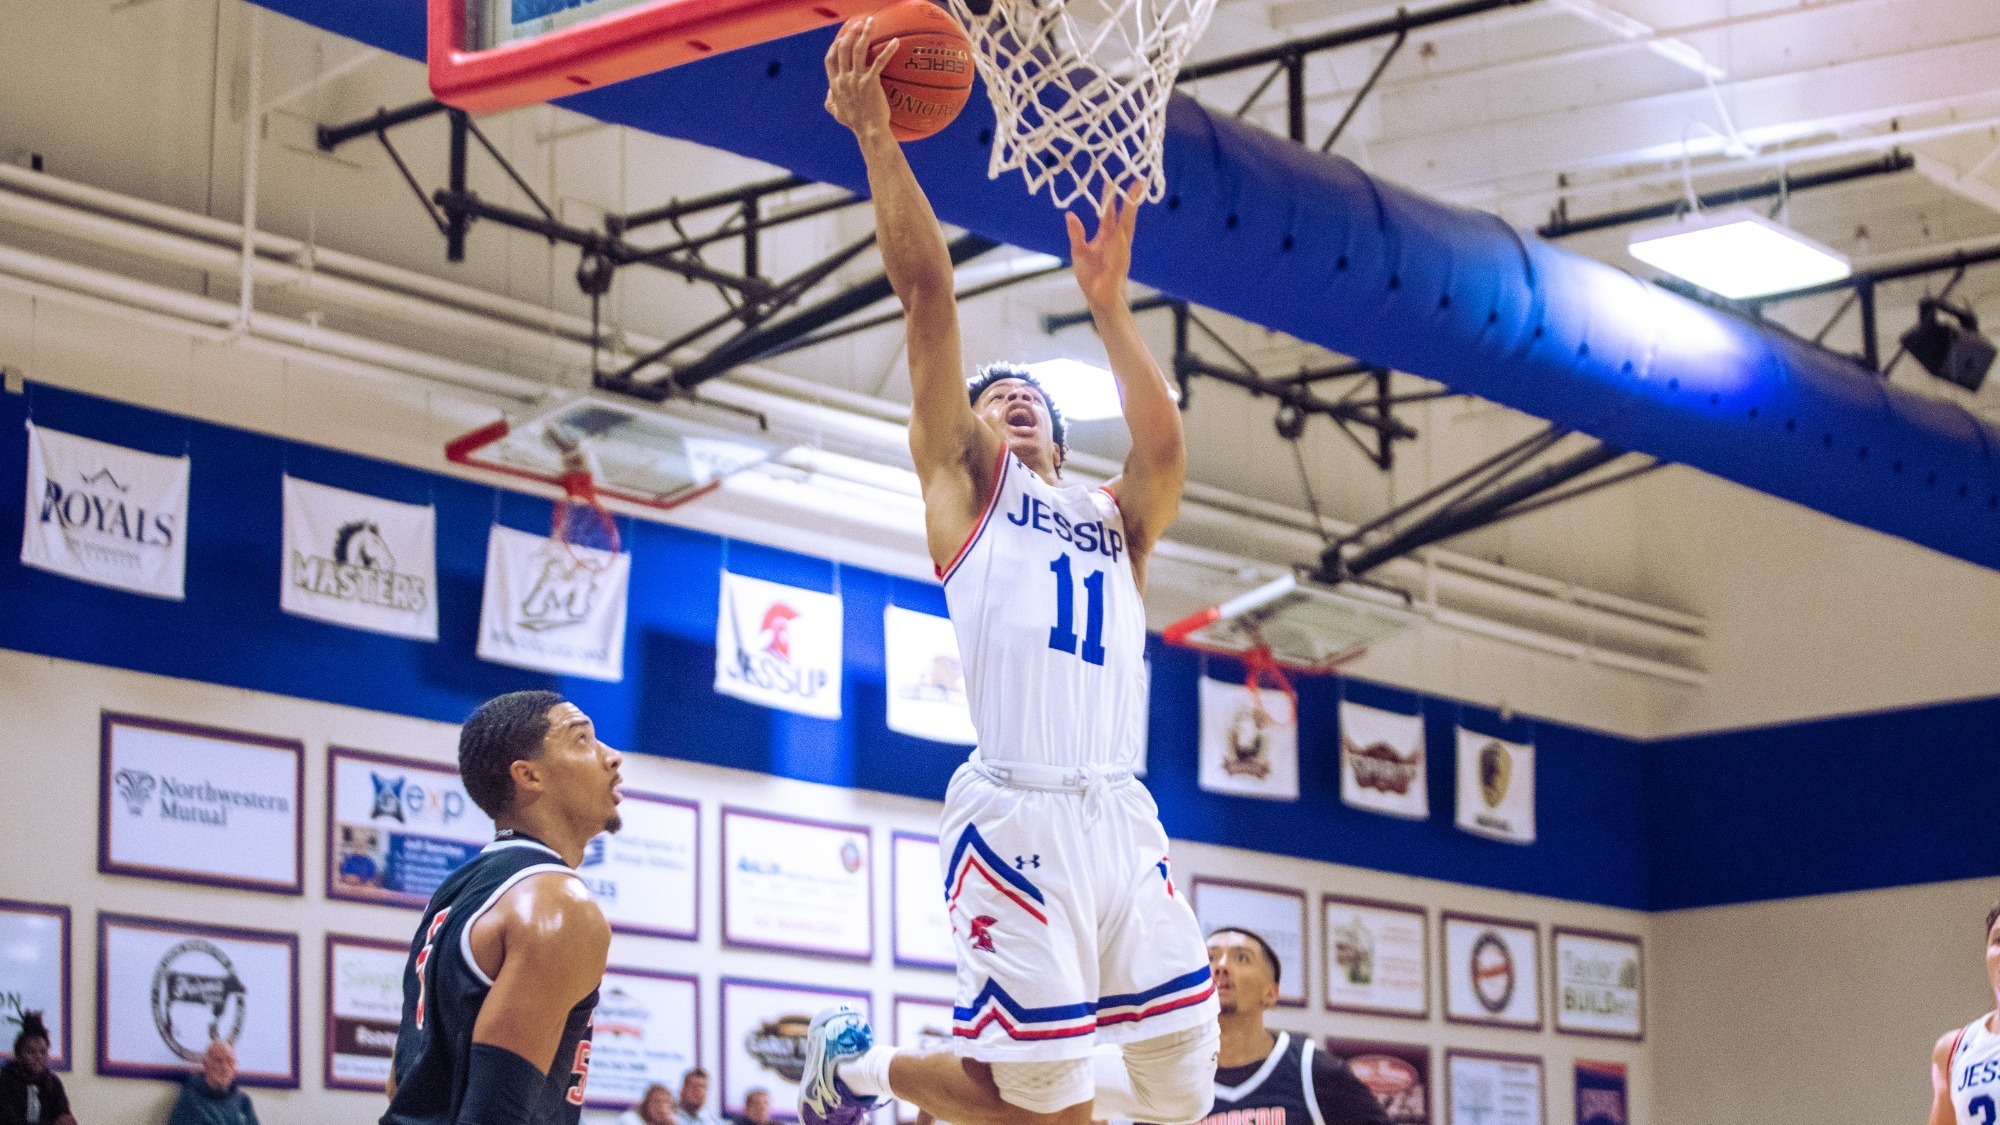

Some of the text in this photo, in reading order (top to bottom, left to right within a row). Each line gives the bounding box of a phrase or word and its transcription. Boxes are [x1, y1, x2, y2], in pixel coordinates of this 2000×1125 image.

[903, 56, 967, 75] EGACY
[40, 477, 176, 548] ROYALS
[291, 549, 428, 614] MASTERS
[1048, 551, 1106, 667] 11
[160, 774, 290, 812] Northwestern
[160, 797, 228, 827] Mutual
[1957, 1060, 2000, 1092] JES
